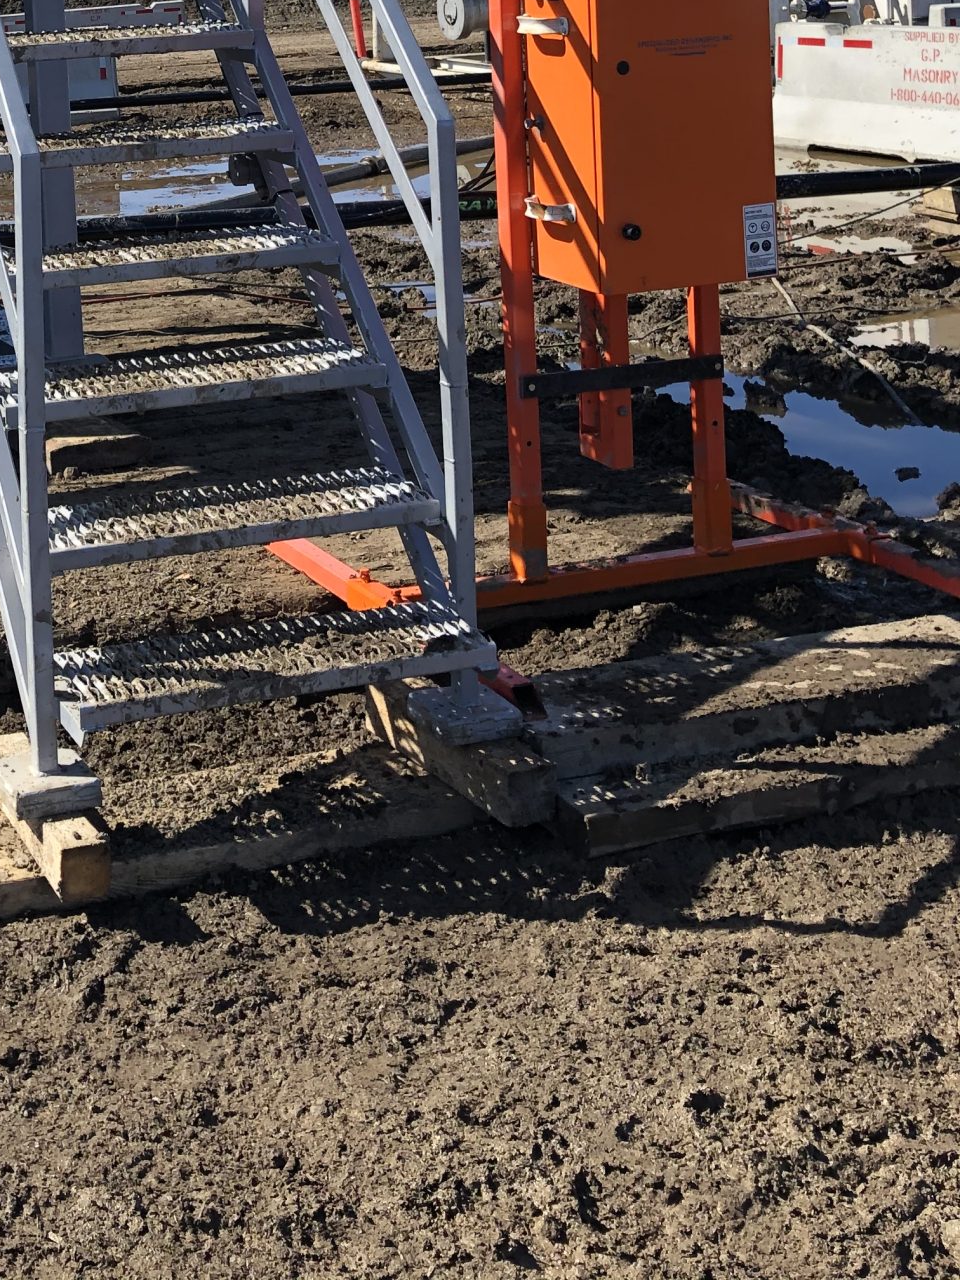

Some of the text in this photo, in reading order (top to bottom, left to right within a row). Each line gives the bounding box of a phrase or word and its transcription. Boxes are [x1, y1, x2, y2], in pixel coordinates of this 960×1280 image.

[904, 31, 945, 43] SUPPLIED
[921, 48, 944, 63] G.P.
[903, 67, 958, 84] MASONRY
